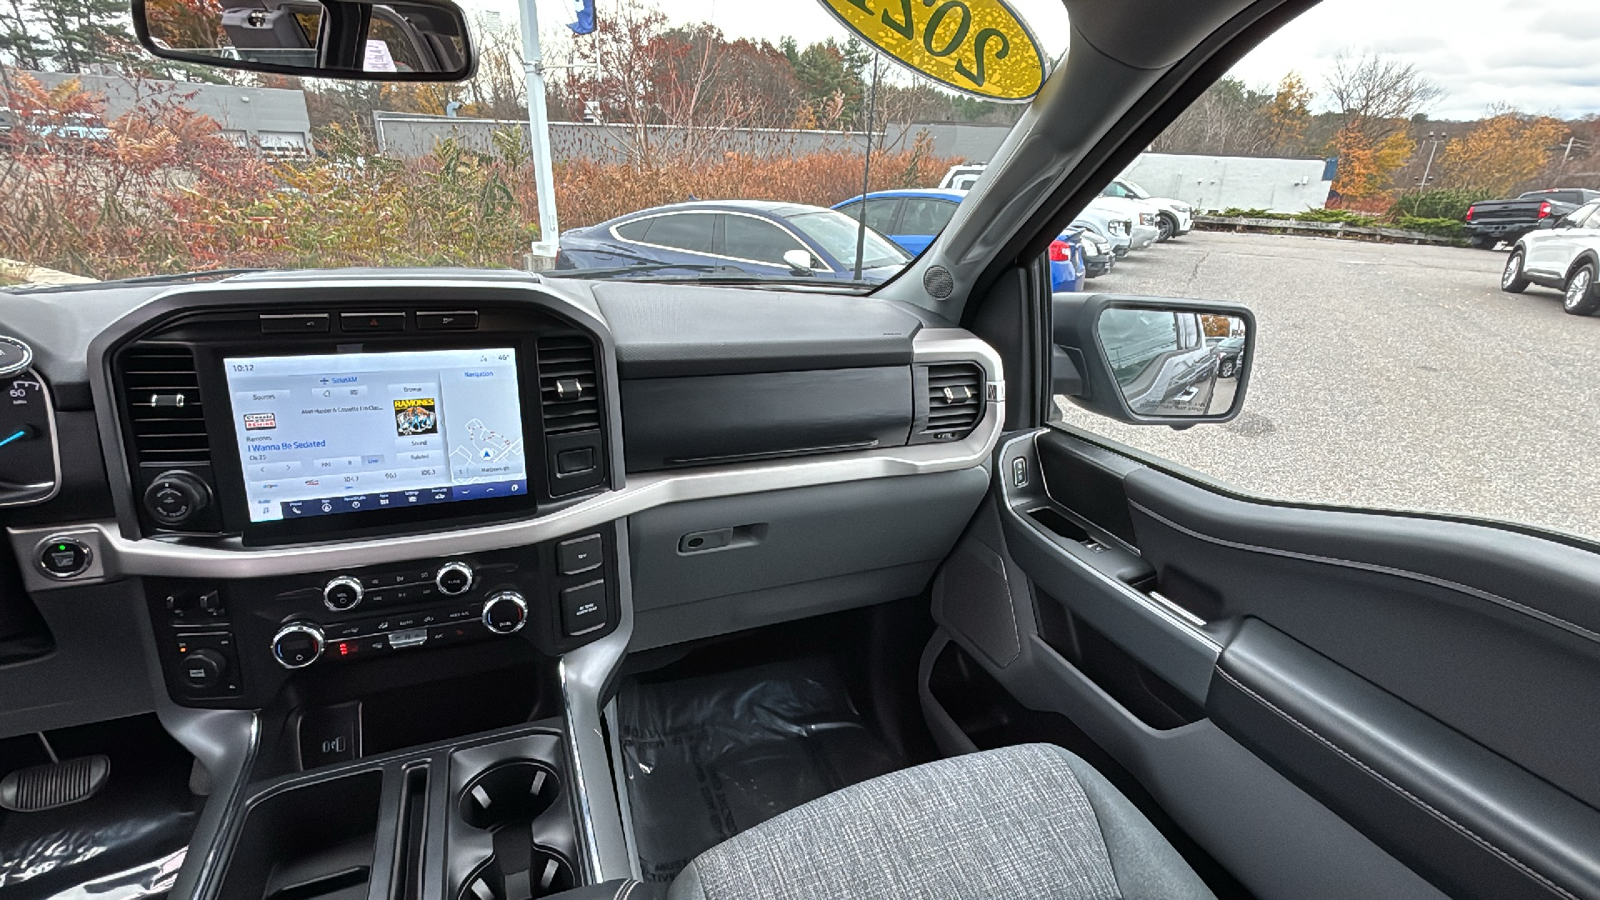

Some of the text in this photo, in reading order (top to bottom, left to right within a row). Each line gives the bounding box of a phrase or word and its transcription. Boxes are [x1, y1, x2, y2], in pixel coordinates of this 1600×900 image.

[233, 364, 254, 372] 10:12
[331, 376, 358, 384] SiriusXM
[10, 389, 25, 397] 60
[252, 393, 276, 401] Sources
[394, 399, 435, 409] RAMONES
[253, 444, 281, 452] Wanna
[293, 440, 326, 449] Sedated
